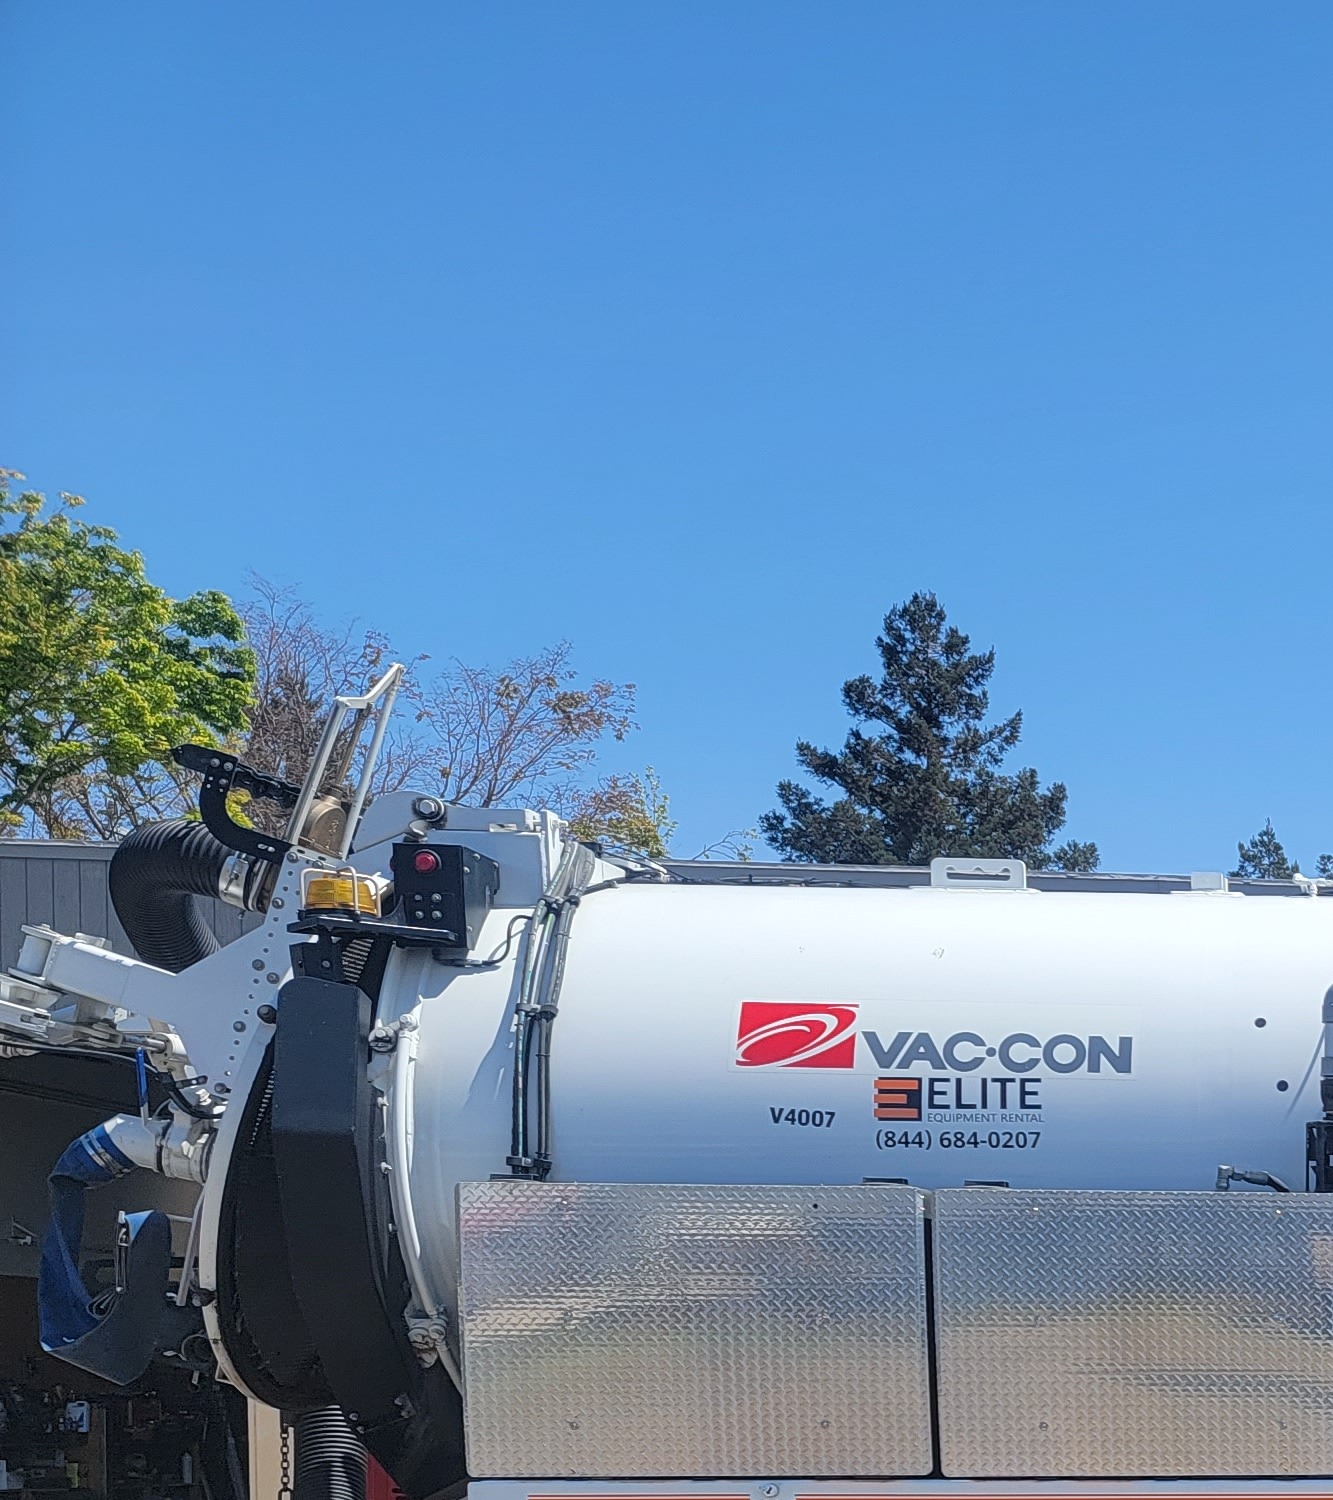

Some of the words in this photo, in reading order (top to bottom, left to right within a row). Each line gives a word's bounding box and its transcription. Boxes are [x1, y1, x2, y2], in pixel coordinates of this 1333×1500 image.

[927, 1078, 1042, 1109] ELITE
[769, 1106, 836, 1129] V4007
[927, 1113, 997, 1123] EQUIPMENT
[1000, 1113, 1045, 1123] RENTAL
[876, 1129, 932, 1150] (844)
[939, 1131, 1041, 1149] 684-0207
